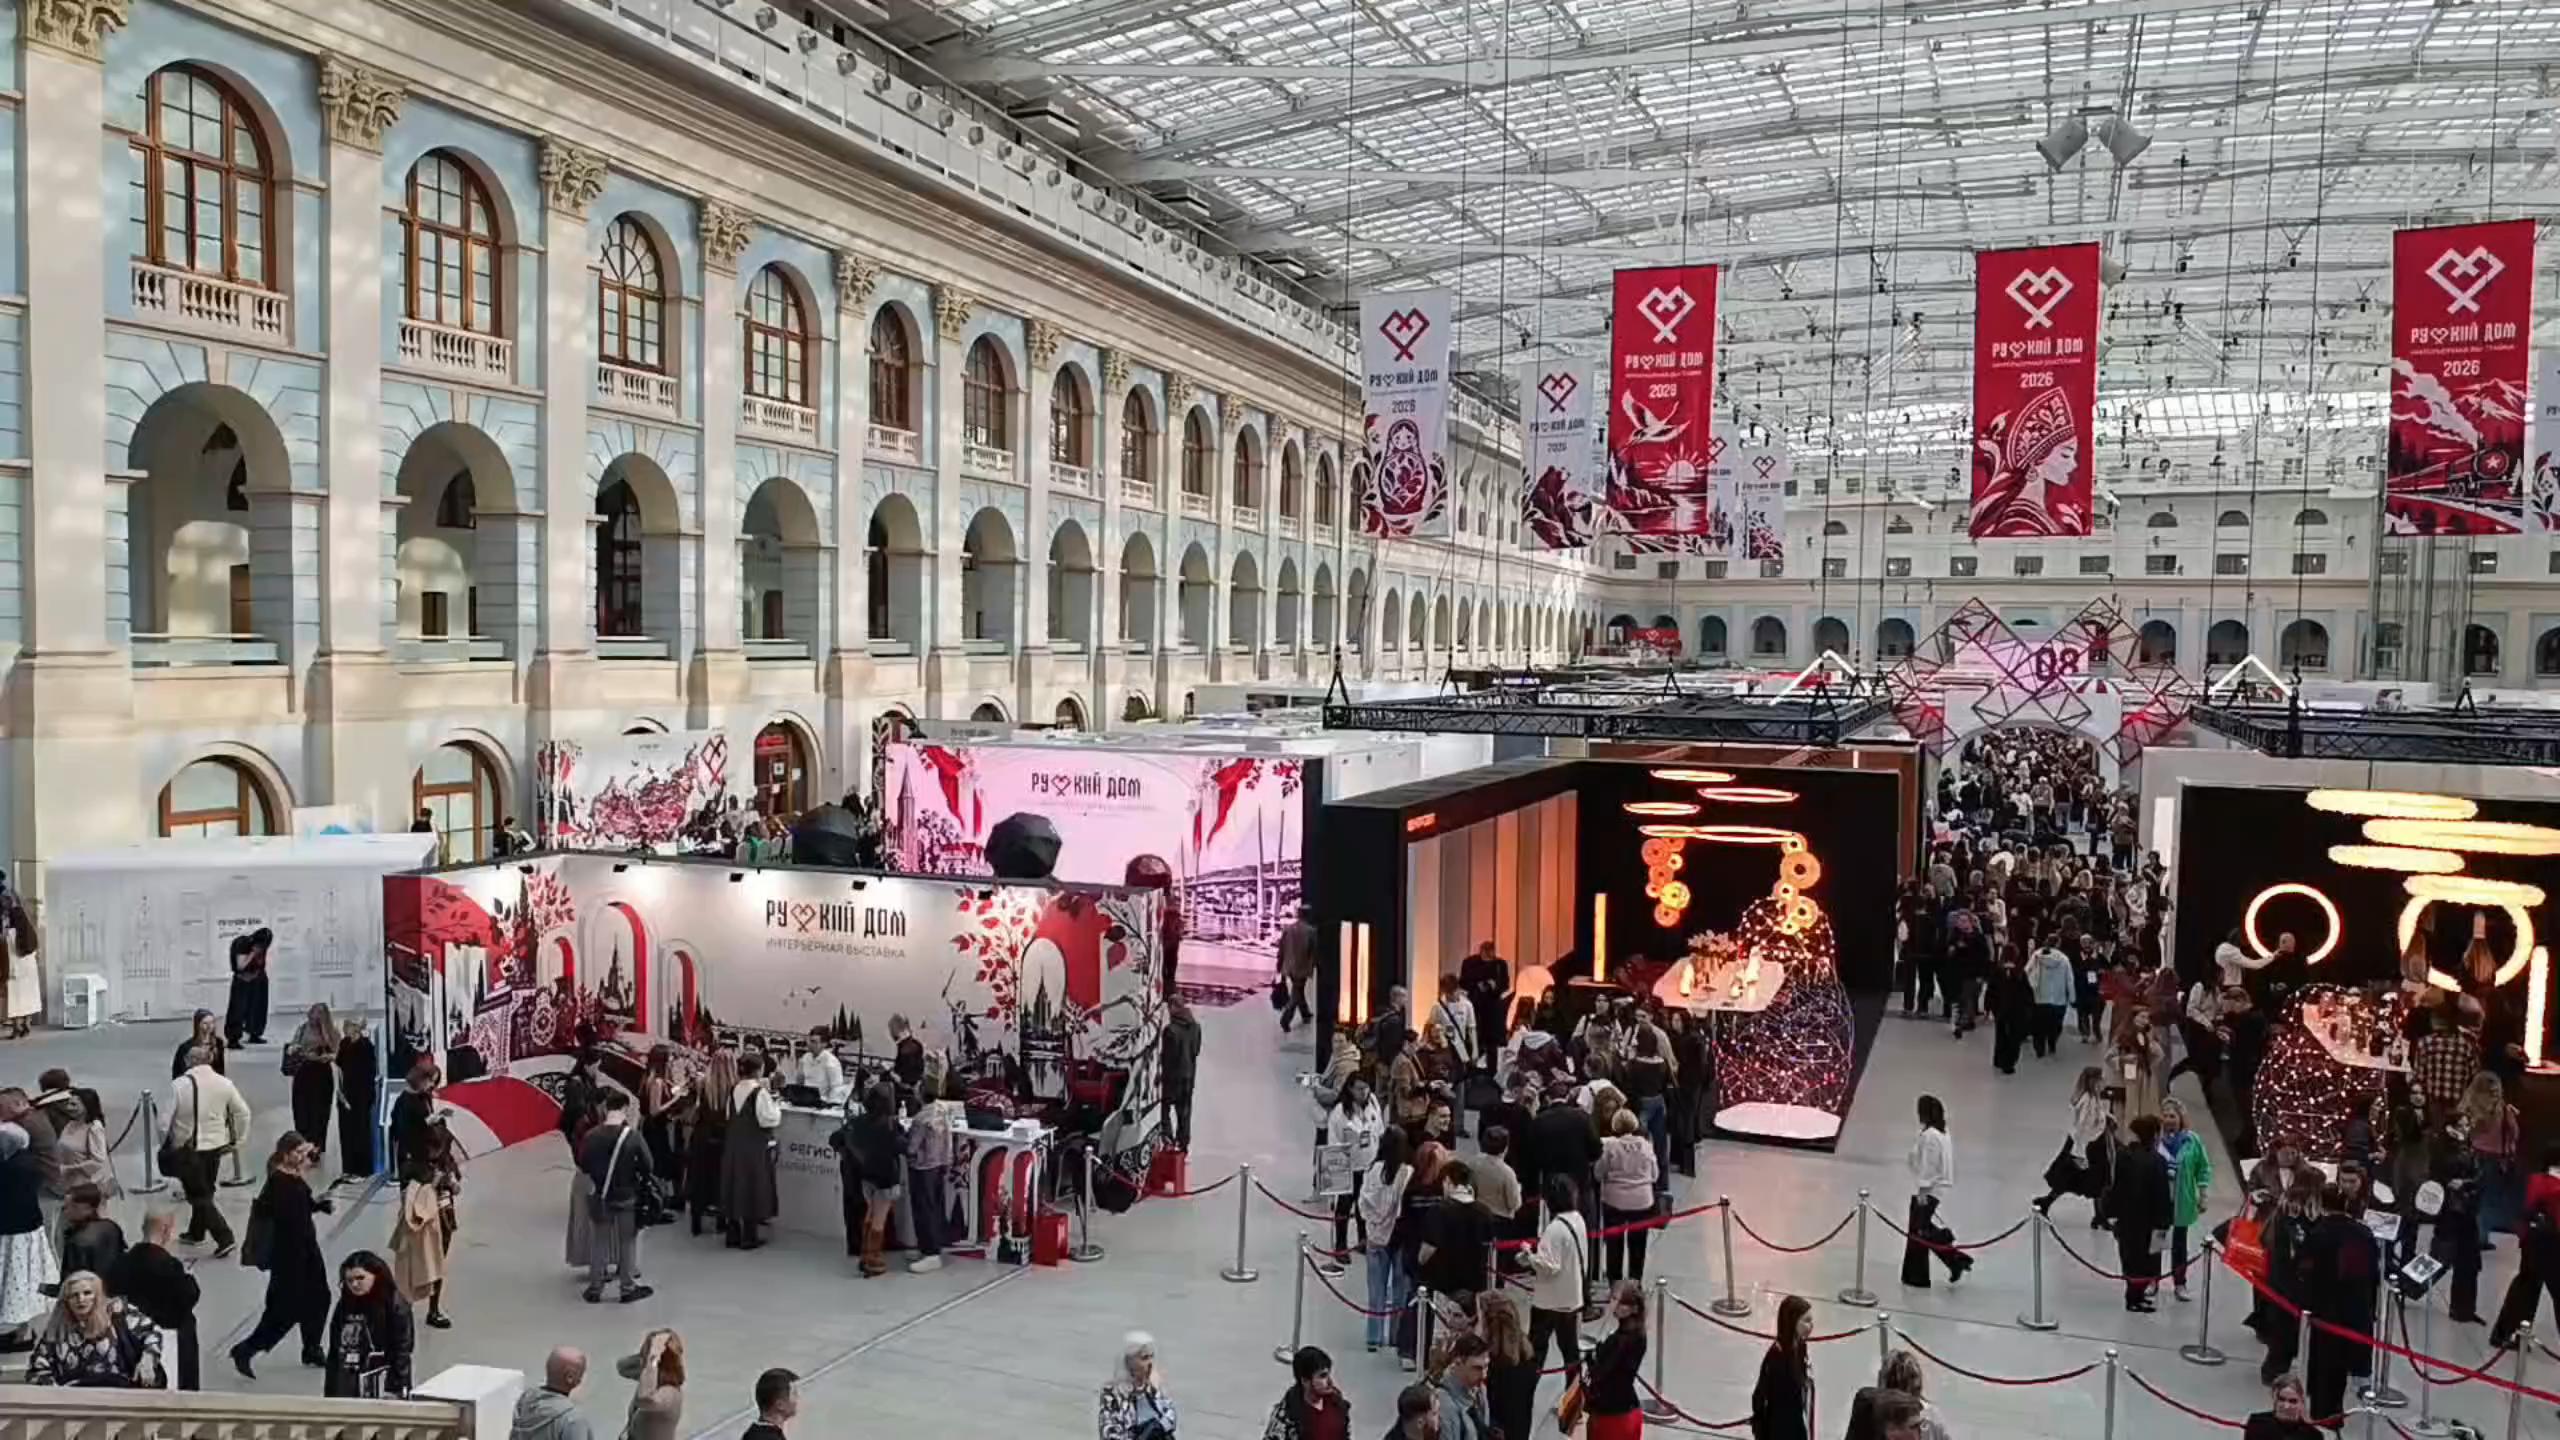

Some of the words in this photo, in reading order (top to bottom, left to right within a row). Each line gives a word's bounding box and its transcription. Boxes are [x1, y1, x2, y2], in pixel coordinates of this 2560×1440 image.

[2484, 321, 2517, 342] ДОМ
[2056, 337, 2084, 356] ДОМ
[2442, 359, 2481, 377] 2026
[2020, 371, 2054, 389] 2026
[1106, 776, 1142, 799] ДОМ
[863, 906, 906, 938] ДОМ
[846, 944, 906, 959] ВЫСТАВКА
